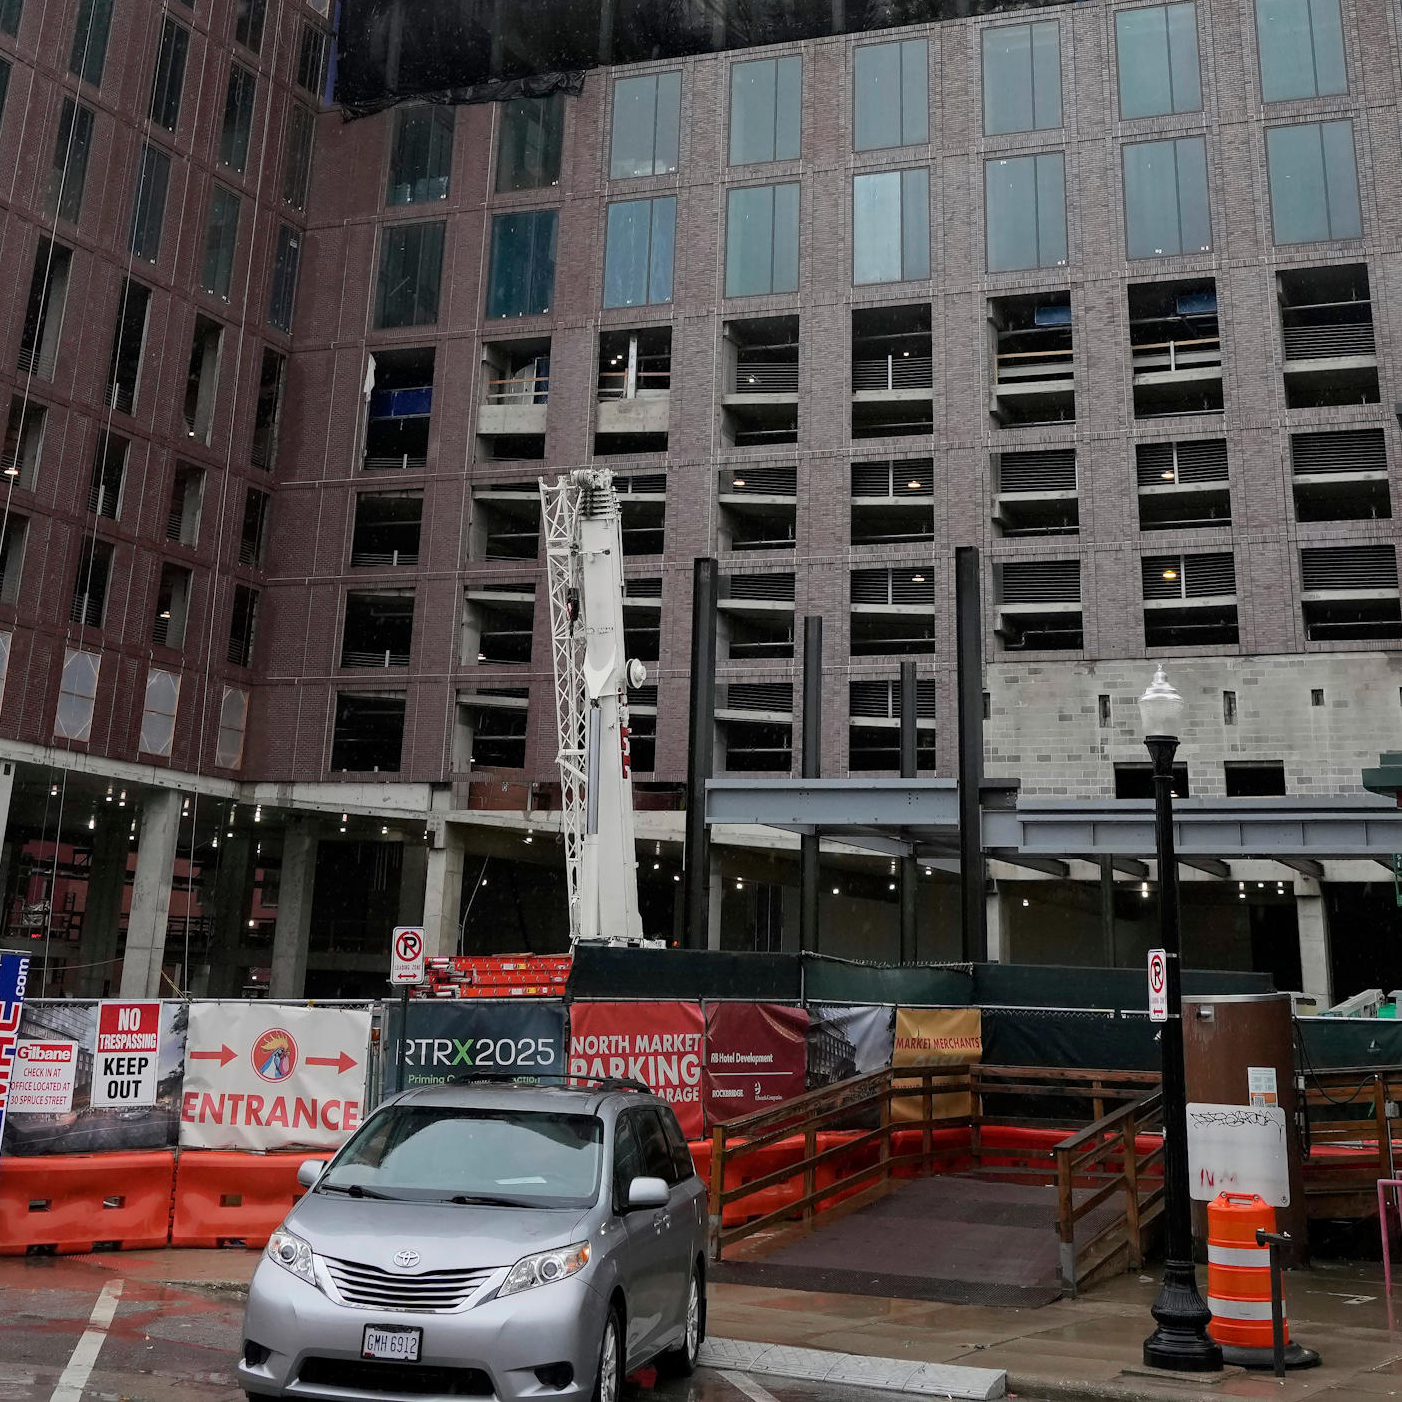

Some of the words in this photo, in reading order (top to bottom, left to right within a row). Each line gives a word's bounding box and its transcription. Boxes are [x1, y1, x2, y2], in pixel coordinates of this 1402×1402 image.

[117, 1007, 141, 1032] NO
[99, 1033, 158, 1050] TRESPASSING
[570, 1035, 630, 1055] NORTH
[635, 1033, 702, 1053] MARKET
[896, 1037, 931, 1050] MARKET
[933, 1037, 980, 1050] MERCHANTS
[17, 1046, 72, 1061] Gilbane
[395, 1038, 555, 1066] RTRX2025
[710, 1052, 719, 1063] RB
[719, 1052, 735, 1063] Hotel
[735, 1051, 774, 1065] Development
[23, 1067, 45, 1078] CHECK
[45, 1068, 53, 1078] IN
[52, 1068, 62, 1078] AT
[103, 1057, 149, 1076] KEEP
[570, 1054, 701, 1087] PARKING
[10, 1081, 33, 1092] OFFICE
[33, 1081, 62, 1092] LOCATED
[63, 1082, 71, 1092] AT
[408, 1074, 445, 1086] Priming
[107, 1080, 142, 1099] OUT
[650, 1086, 700, 1103] ARAGE
[10, 1096, 19, 1105] 30
[19, 1096, 45, 1106] SPRUCE
[46, 1096, 67, 1106] STREET
[181, 1093, 359, 1133] ENTRANCE
[367, 1334, 388, 1352] GMH
[390, 1336, 417, 1354] 6912
